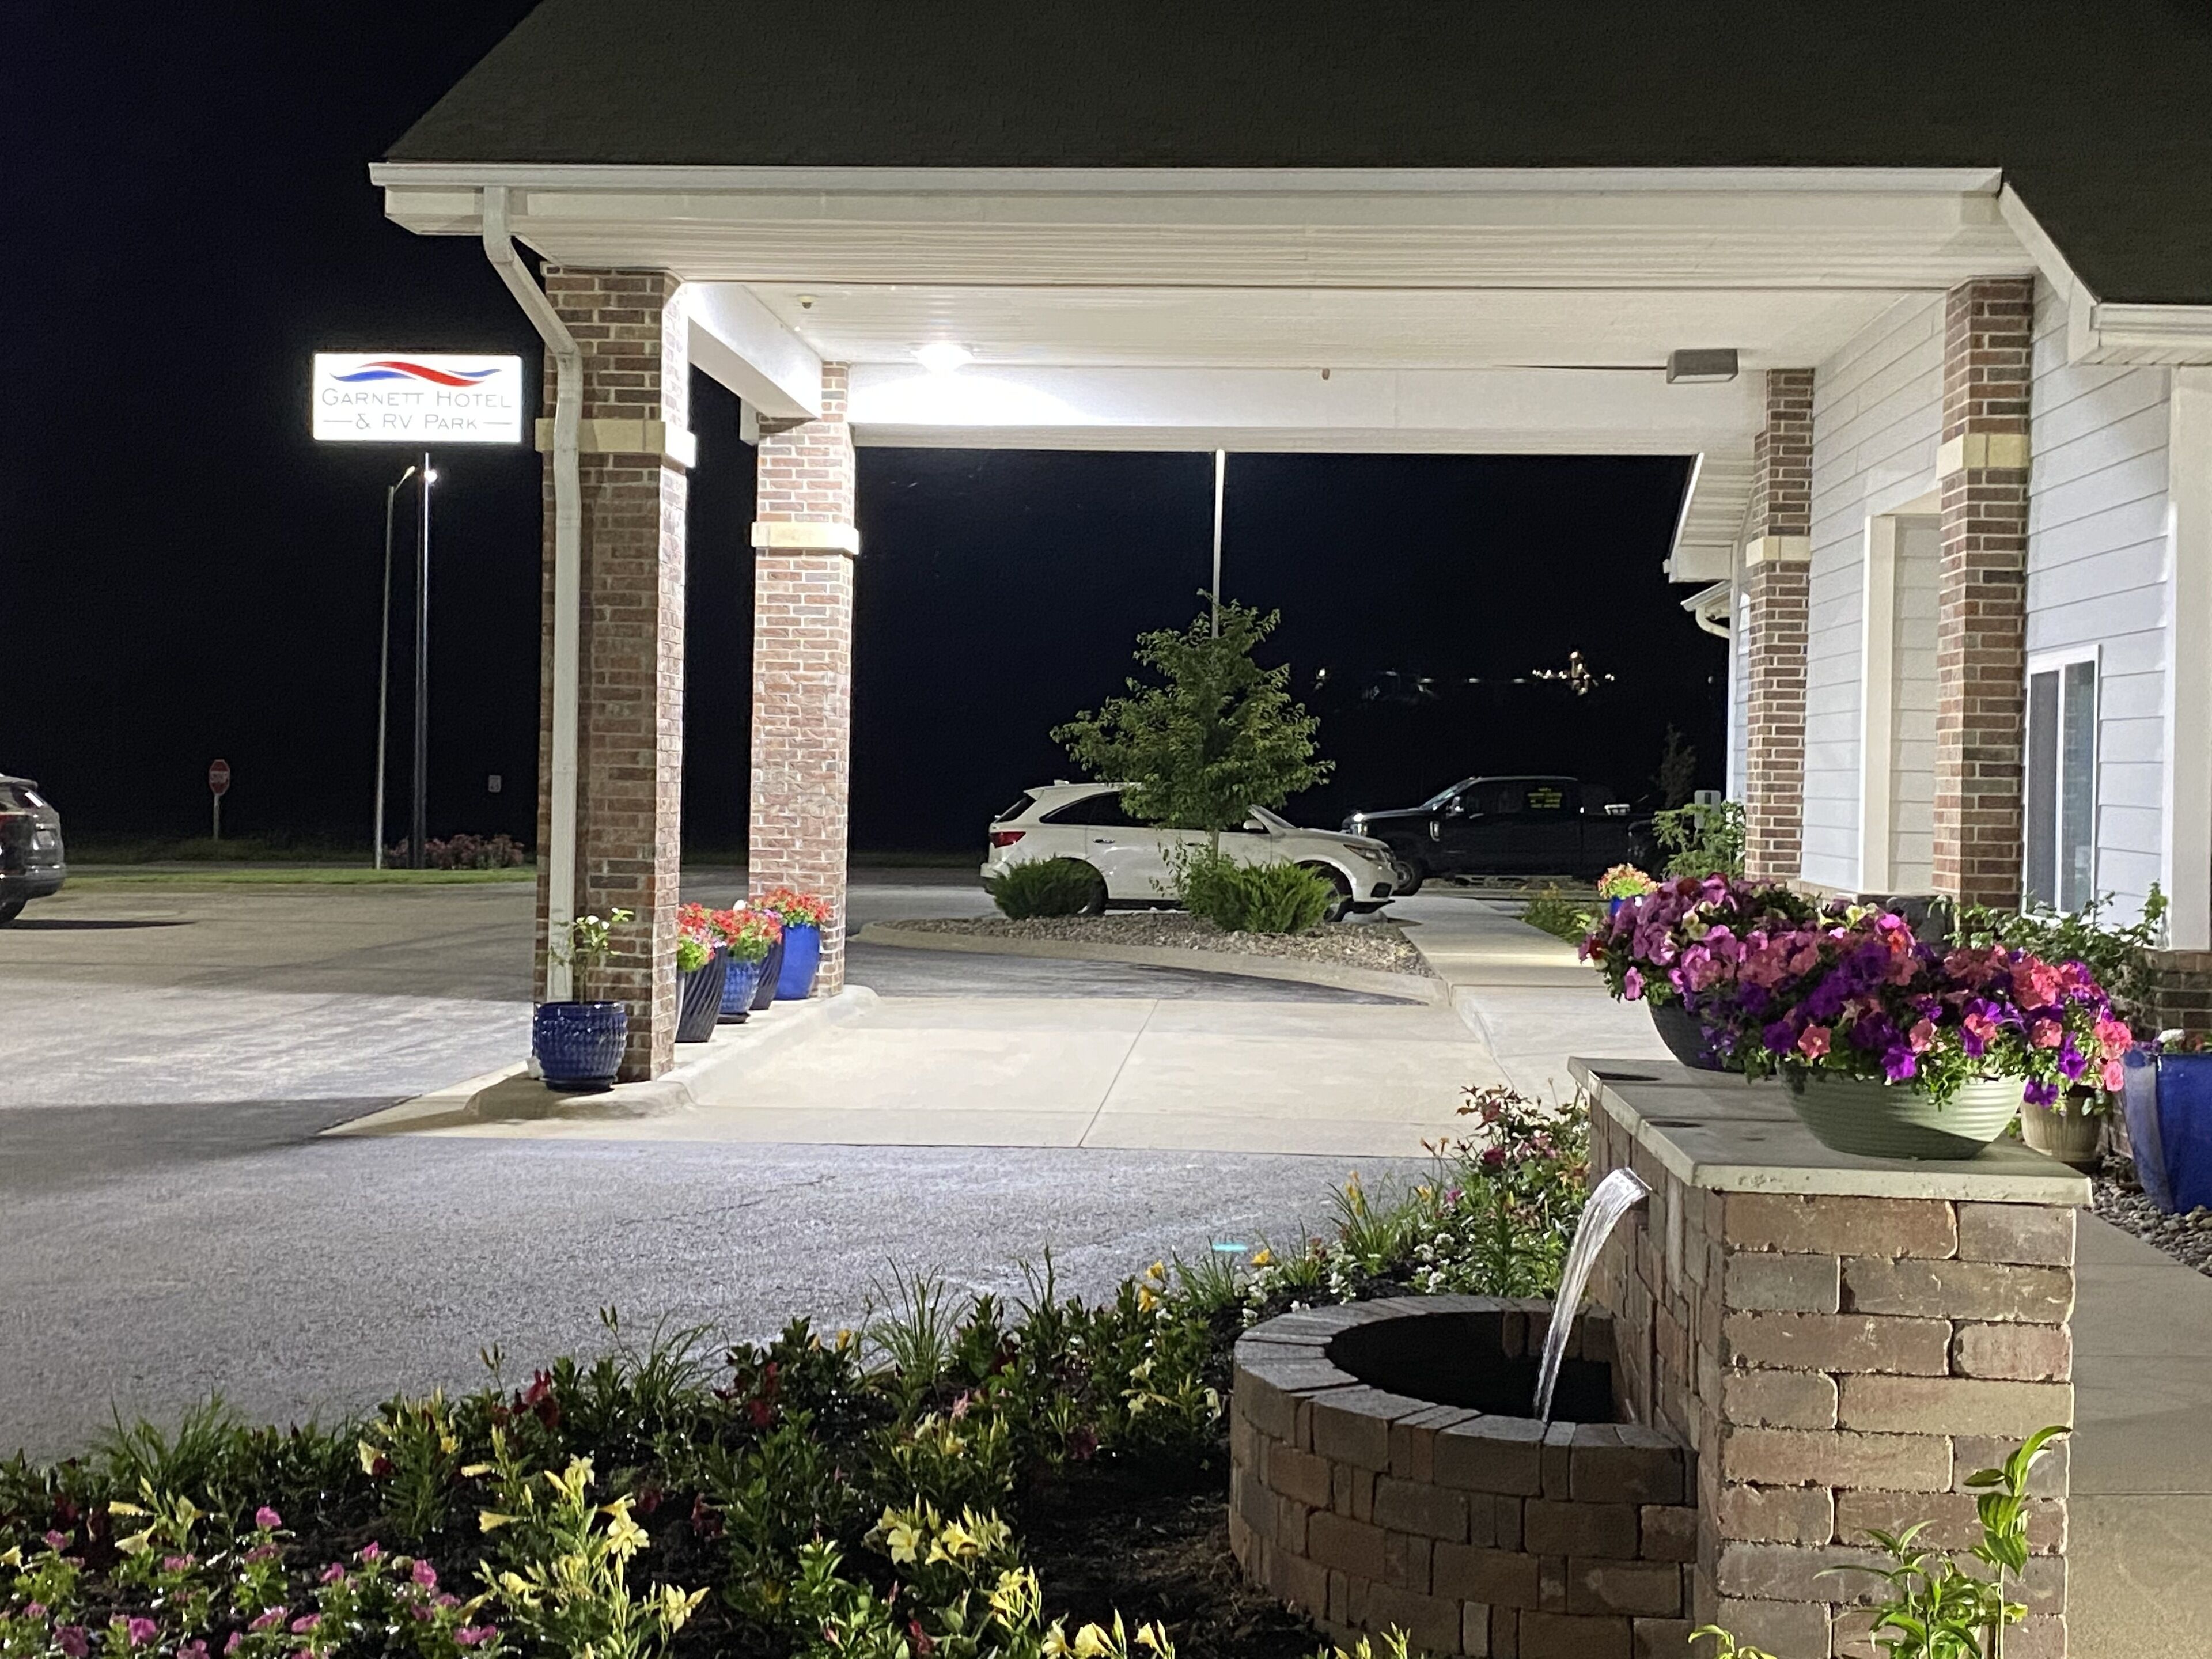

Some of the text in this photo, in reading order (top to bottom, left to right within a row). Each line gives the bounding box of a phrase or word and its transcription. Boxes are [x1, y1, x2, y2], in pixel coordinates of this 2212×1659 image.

[322, 388, 512, 408] GARNETT HOTEL
[355, 413, 478, 430] & RV PARK
